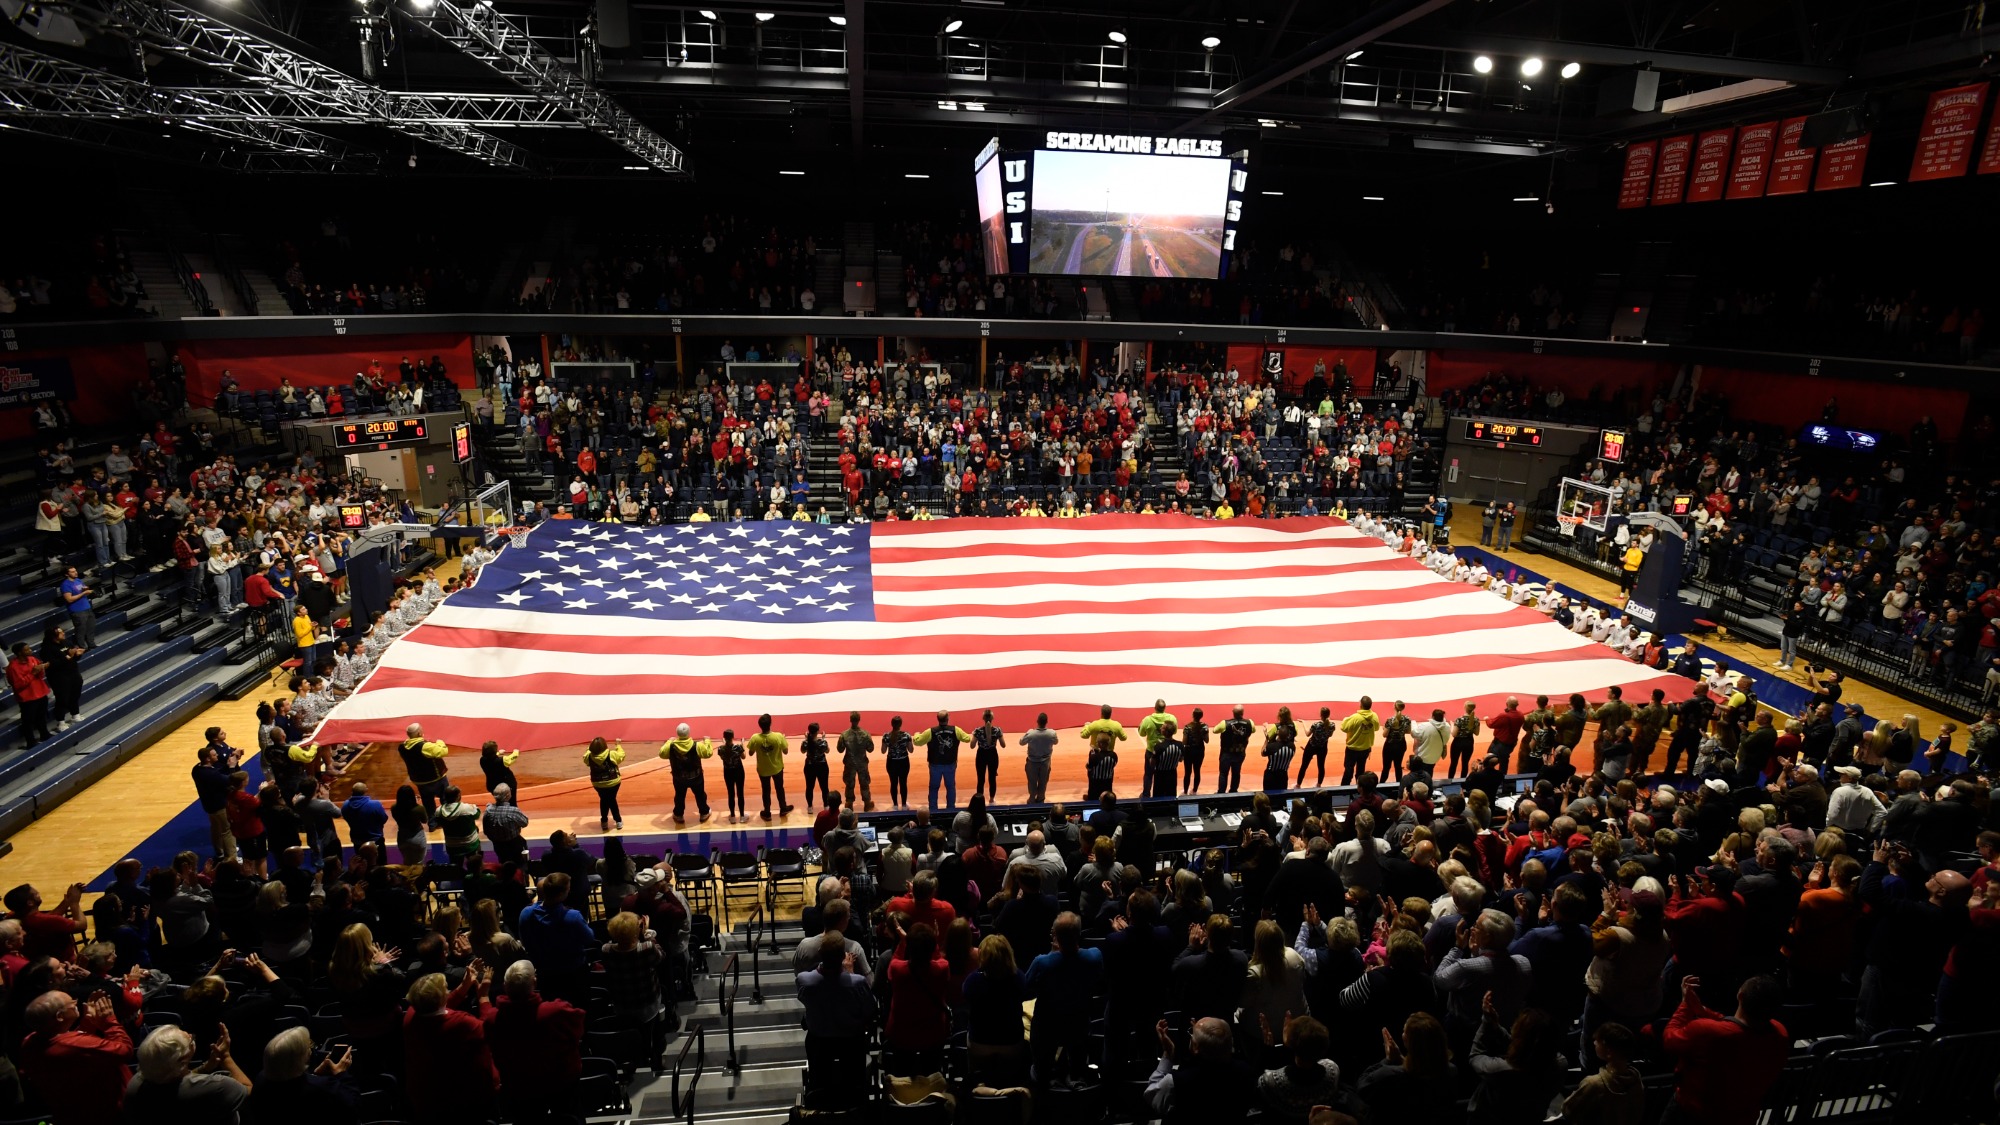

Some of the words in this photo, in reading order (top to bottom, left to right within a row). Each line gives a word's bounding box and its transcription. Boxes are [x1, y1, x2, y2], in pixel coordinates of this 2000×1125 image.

[1932, 96, 1978, 112] INDIANA
[1931, 114, 1971, 126] BASKETBALL
[1934, 124, 1963, 134] GLVC
[1046, 131, 1152, 154] SCREAMING
[1155, 137, 1222, 157] EAGLES
[1785, 149, 1806, 158] GLVC
[1004, 160, 1027, 244] USI
[1223, 170, 1248, 251] USI
[333, 318, 345, 326] 207
[1, 328, 16, 338] 208
[5, 340, 19, 350] 108
[1810, 358, 1821, 367] 202
[1809, 367, 1819, 376] 102
[31, 390, 55, 400] SECTION
[367, 421, 396, 433] 20:00
[416, 427, 423, 436] 0
[1492, 424, 1517, 434] 20:00
[348, 433, 356, 443] 0
[1475, 429, 1482, 438] 0
[1604, 432, 1624, 444] 20:00
[1532, 435, 1540, 444] 0
[1604, 442, 1620, 459] 30
[341, 506, 362, 516] 20:00
[1675, 504, 1687, 513] 30
[345, 515, 361, 526] 30
[1627, 600, 1657, 619] Romain
